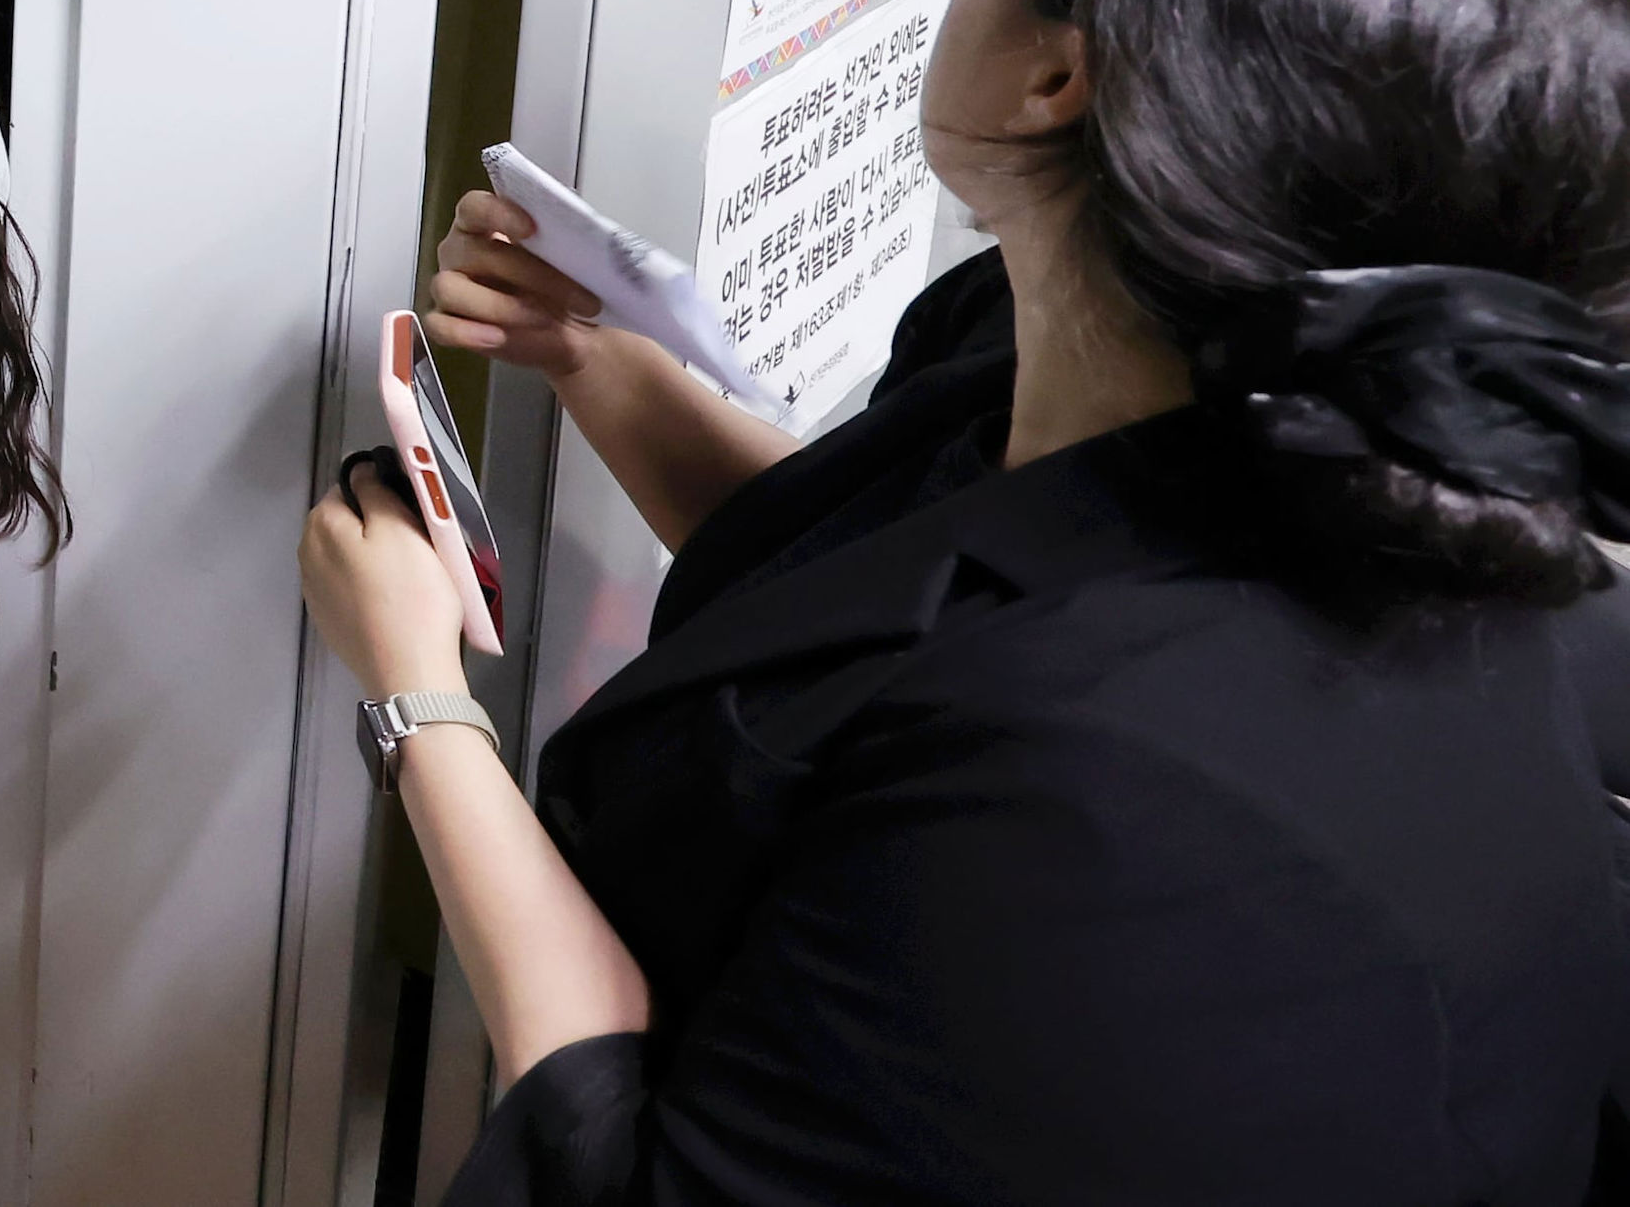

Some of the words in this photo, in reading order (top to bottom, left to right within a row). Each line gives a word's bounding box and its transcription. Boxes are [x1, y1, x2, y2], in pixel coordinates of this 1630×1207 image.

[716, 128, 824, 245] (사전)투표소에
[827, 93, 870, 160] 출입할
[874, 84, 889, 122] 수
[894, 59, 927, 111] 없습
[761, 77, 838, 159] 투표하려는
[842, 38, 886, 102] 선거인
[888, 13, 929, 65] 외에는
[718, 304, 753, 350] 려는
[759, 267, 789, 323] 경우
[795, 216, 856, 289] 처벌받을
[861, 203, 874, 241] 수
[879, 160, 930, 227] 있습니다.
[721, 249, 753, 303] 이미
[758, 208, 805, 276] 투표한
[809, 171, 856, 232] 사람이
[861, 146, 888, 195] 다시
[789, 268, 865, 352] 제163조제1항,
